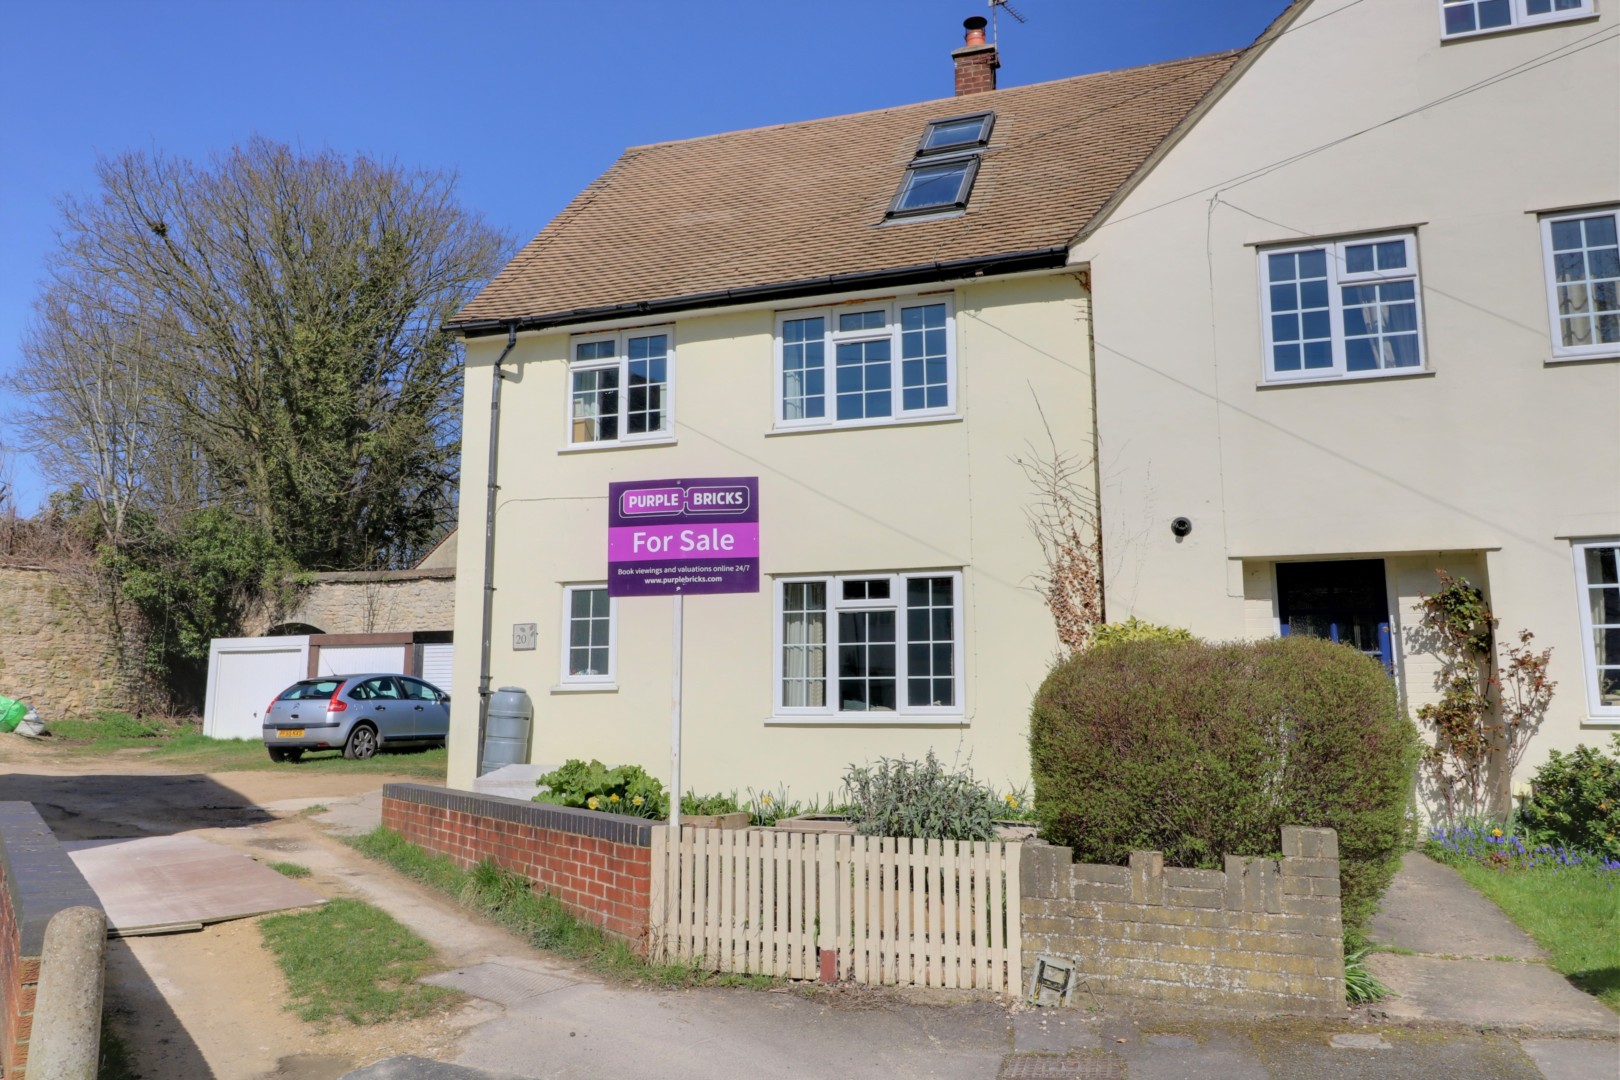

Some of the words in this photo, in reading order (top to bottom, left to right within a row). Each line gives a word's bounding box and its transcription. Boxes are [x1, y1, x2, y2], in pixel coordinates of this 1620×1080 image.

[628, 493, 679, 508] PURPLE
[693, 491, 743, 505] BRICKS
[633, 531, 673, 553] For
[680, 528, 735, 551] Sale
[635, 567, 663, 576] viewings
[677, 565, 712, 573] valuations
[735, 564, 750, 573] 24/7
[644, 575, 723, 585] www.purplebricks.com
[515, 634, 527, 644] 20
